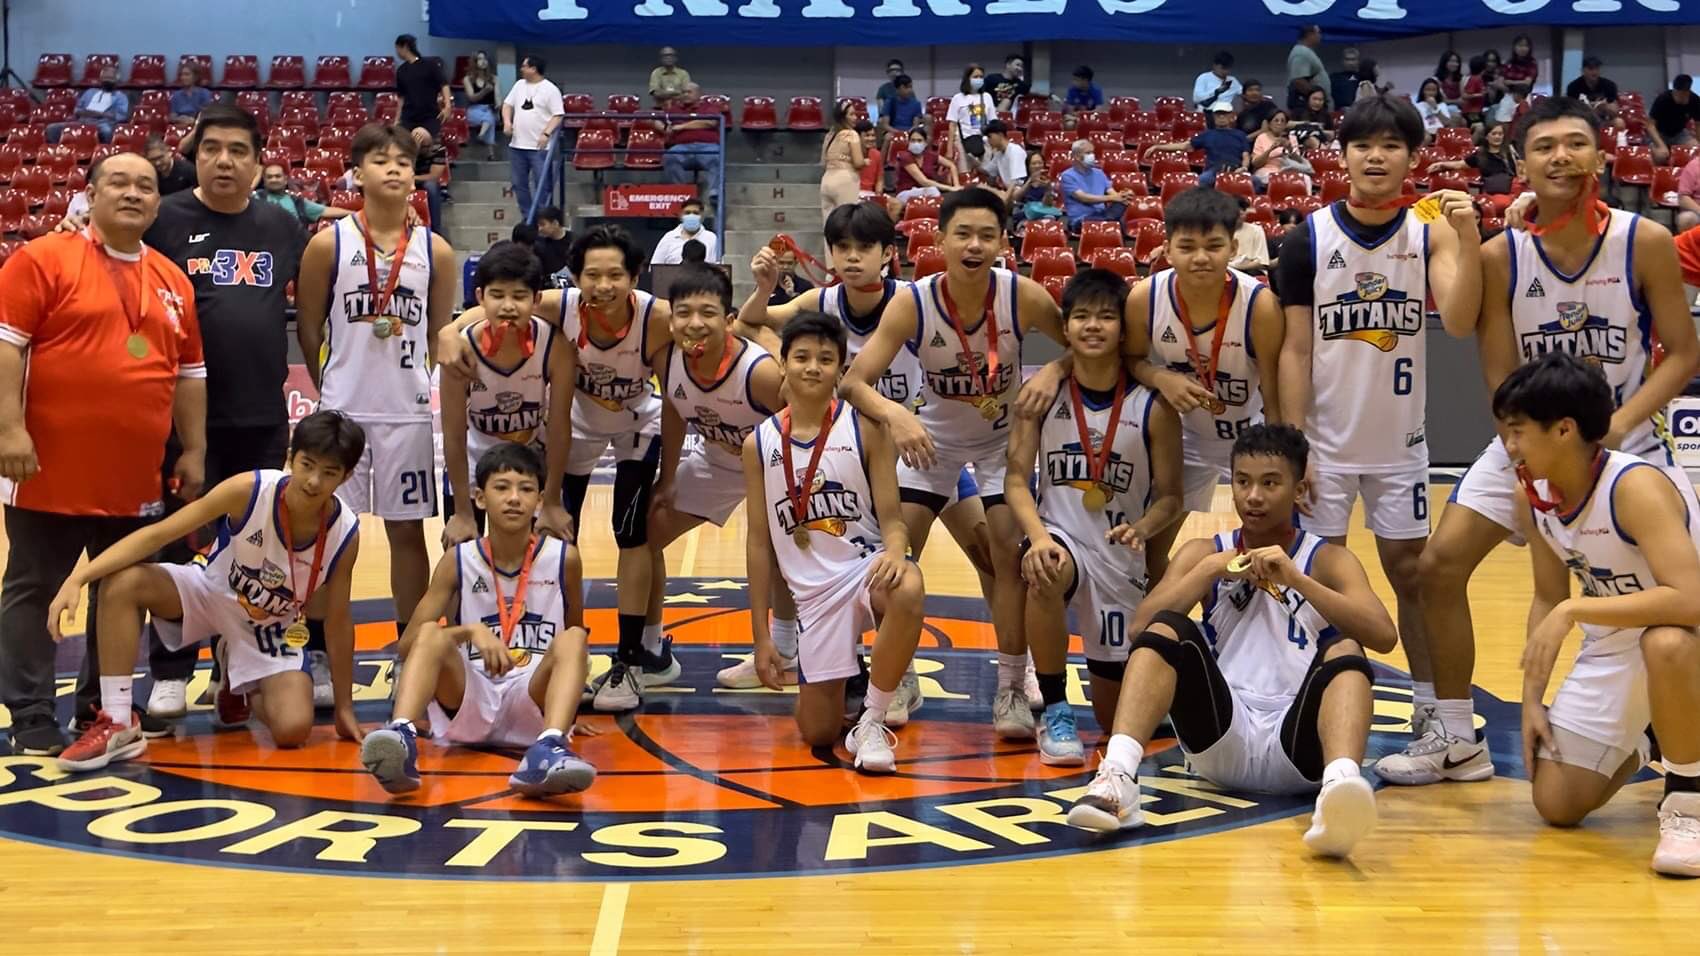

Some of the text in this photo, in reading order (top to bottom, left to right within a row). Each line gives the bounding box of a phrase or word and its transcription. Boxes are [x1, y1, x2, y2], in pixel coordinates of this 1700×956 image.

[628, 194, 691, 203] EMERGENCY
[649, 202, 671, 210] EXIT
[773, 187, 784, 199] H
[213, 249, 273, 287] 3X3
[1319, 300, 1421, 339] TITANS
[1521, 325, 1627, 363] TITANS
[1394, 358, 1413, 395] 6
[470, 410, 540, 435] TITAN
[401, 470, 428, 504] 21
[1047, 450, 1134, 493] TITNS
[1413, 482, 1428, 521] 6
[1100, 610, 1124, 647] 10
[1288, 614, 1308, 650] 4
[0, 755, 728, 868] SPORTS
